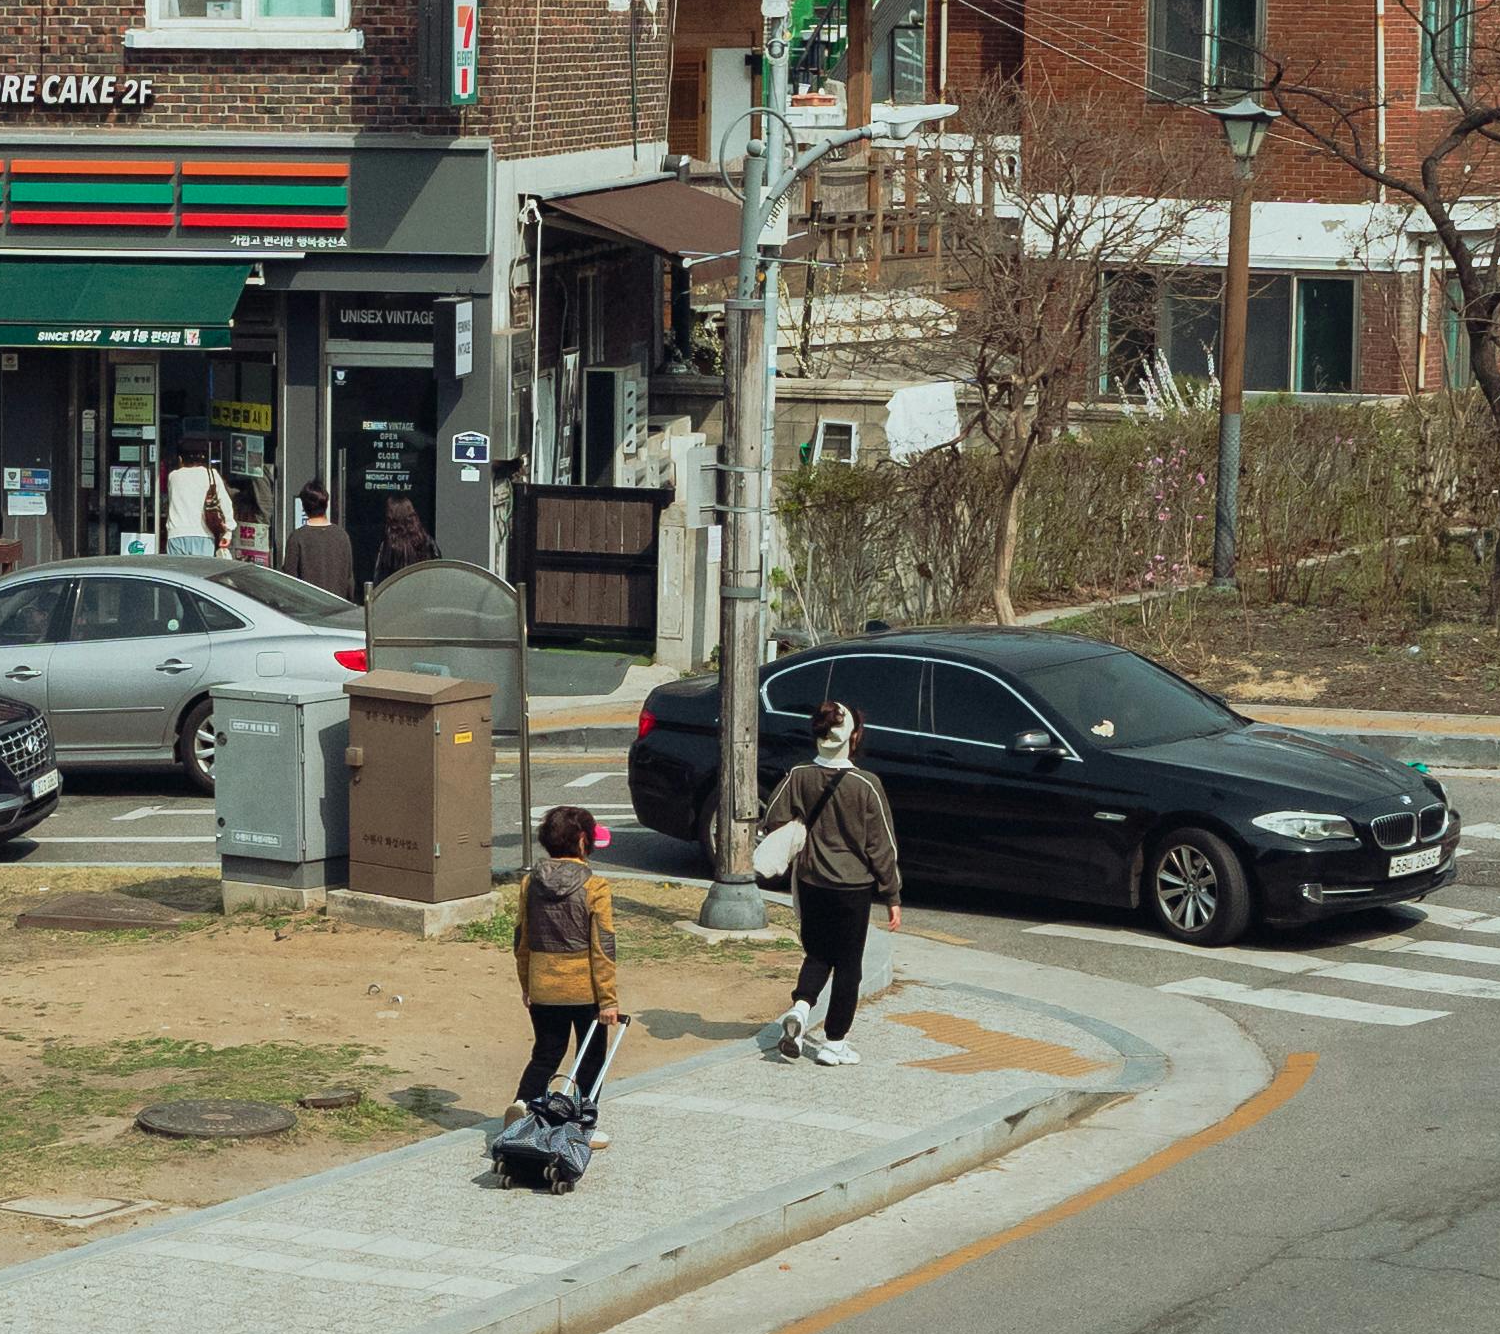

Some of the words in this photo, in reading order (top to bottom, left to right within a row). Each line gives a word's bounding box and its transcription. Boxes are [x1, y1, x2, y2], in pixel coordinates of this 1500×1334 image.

[42, 74, 117, 105] CAKE
[121, 81, 154, 105] 2F
[263, 234, 294, 247] 편리한
[340, 309, 383, 324] UNISEX
[385, 310, 434, 325] VINTAGE
[37, 331, 70, 341] SINCE
[70, 329, 102, 342] 1927
[109, 330, 131, 342] 세계
[132, 328, 149, 343] 1등
[150, 330, 182, 344] 편의점
[378, 452, 400, 460] CLOSE
[465, 446, 476, 459] 4
